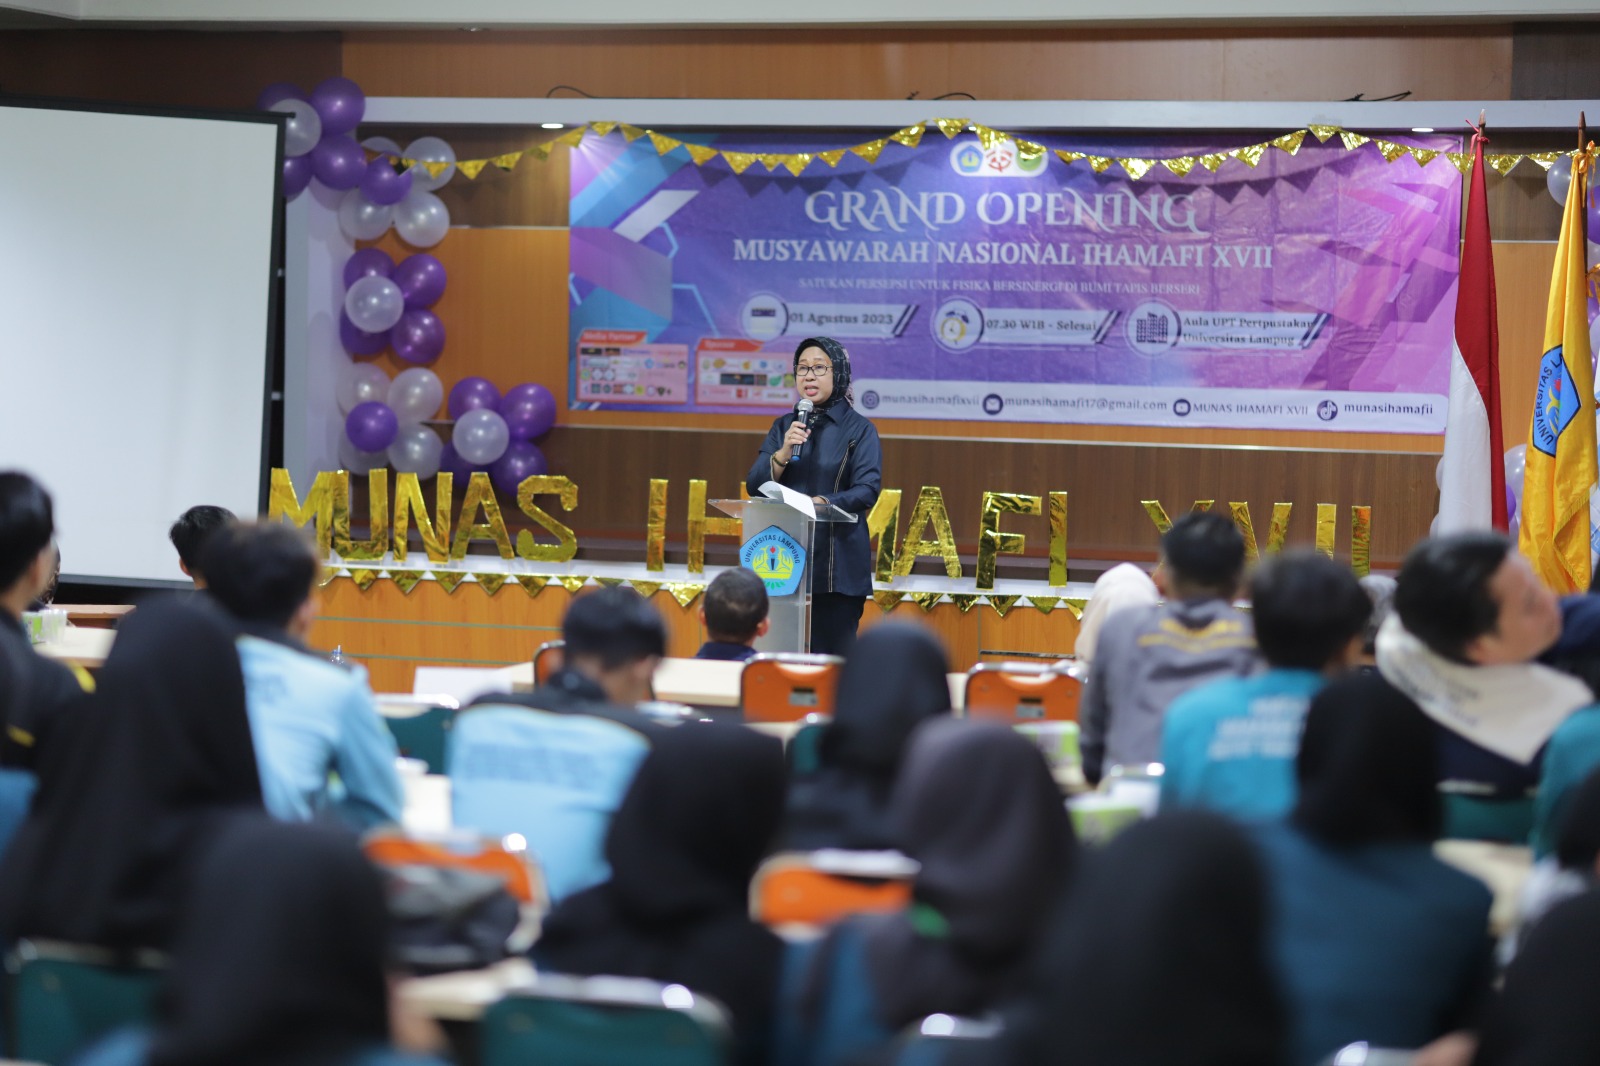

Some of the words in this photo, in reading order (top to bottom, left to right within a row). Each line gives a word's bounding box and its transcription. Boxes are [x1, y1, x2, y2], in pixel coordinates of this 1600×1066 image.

[805, 186, 966, 232] GRAND
[976, 187, 1211, 234] OPENING
[733, 239, 929, 263] MUSYAWARAH
[937, 241, 1076, 265] NASIONAL
[1083, 243, 1204, 267] IHAMAFI
[1212, 245, 1274, 268] XVII
[909, 280, 950, 290] UNTUK
[953, 280, 991, 291] FISIKA
[1080, 283, 1111, 293] BUMI
[1115, 283, 1147, 294] TAPIS
[1151, 284, 1200, 294] BERSERI
[789, 313, 804, 324] 01
[808, 313, 859, 327] Agustus
[862, 314, 894, 325] 2023
[986, 319, 1017, 330] 07.30
[1020, 320, 1045, 331] WIB
[1056, 319, 1097, 332] Selesai
[1184, 317, 1209, 327] Aula
[1213, 317, 1237, 328] UPT
[1184, 333, 1246, 343] Universitas
[1193, 403, 1233, 414] MUNAS
[1236, 404, 1283, 415] IHAMAFI
[1286, 405, 1309, 416] XVII
[1343, 402, 1434, 416] munasihamafii
[1535, 366, 1554, 446] UNIVERSITAS
[268, 467, 578, 562] MUNAS
[744, 534, 777, 563] UNIVERSITAS
[777, 535, 801, 564] LAMPUNG
